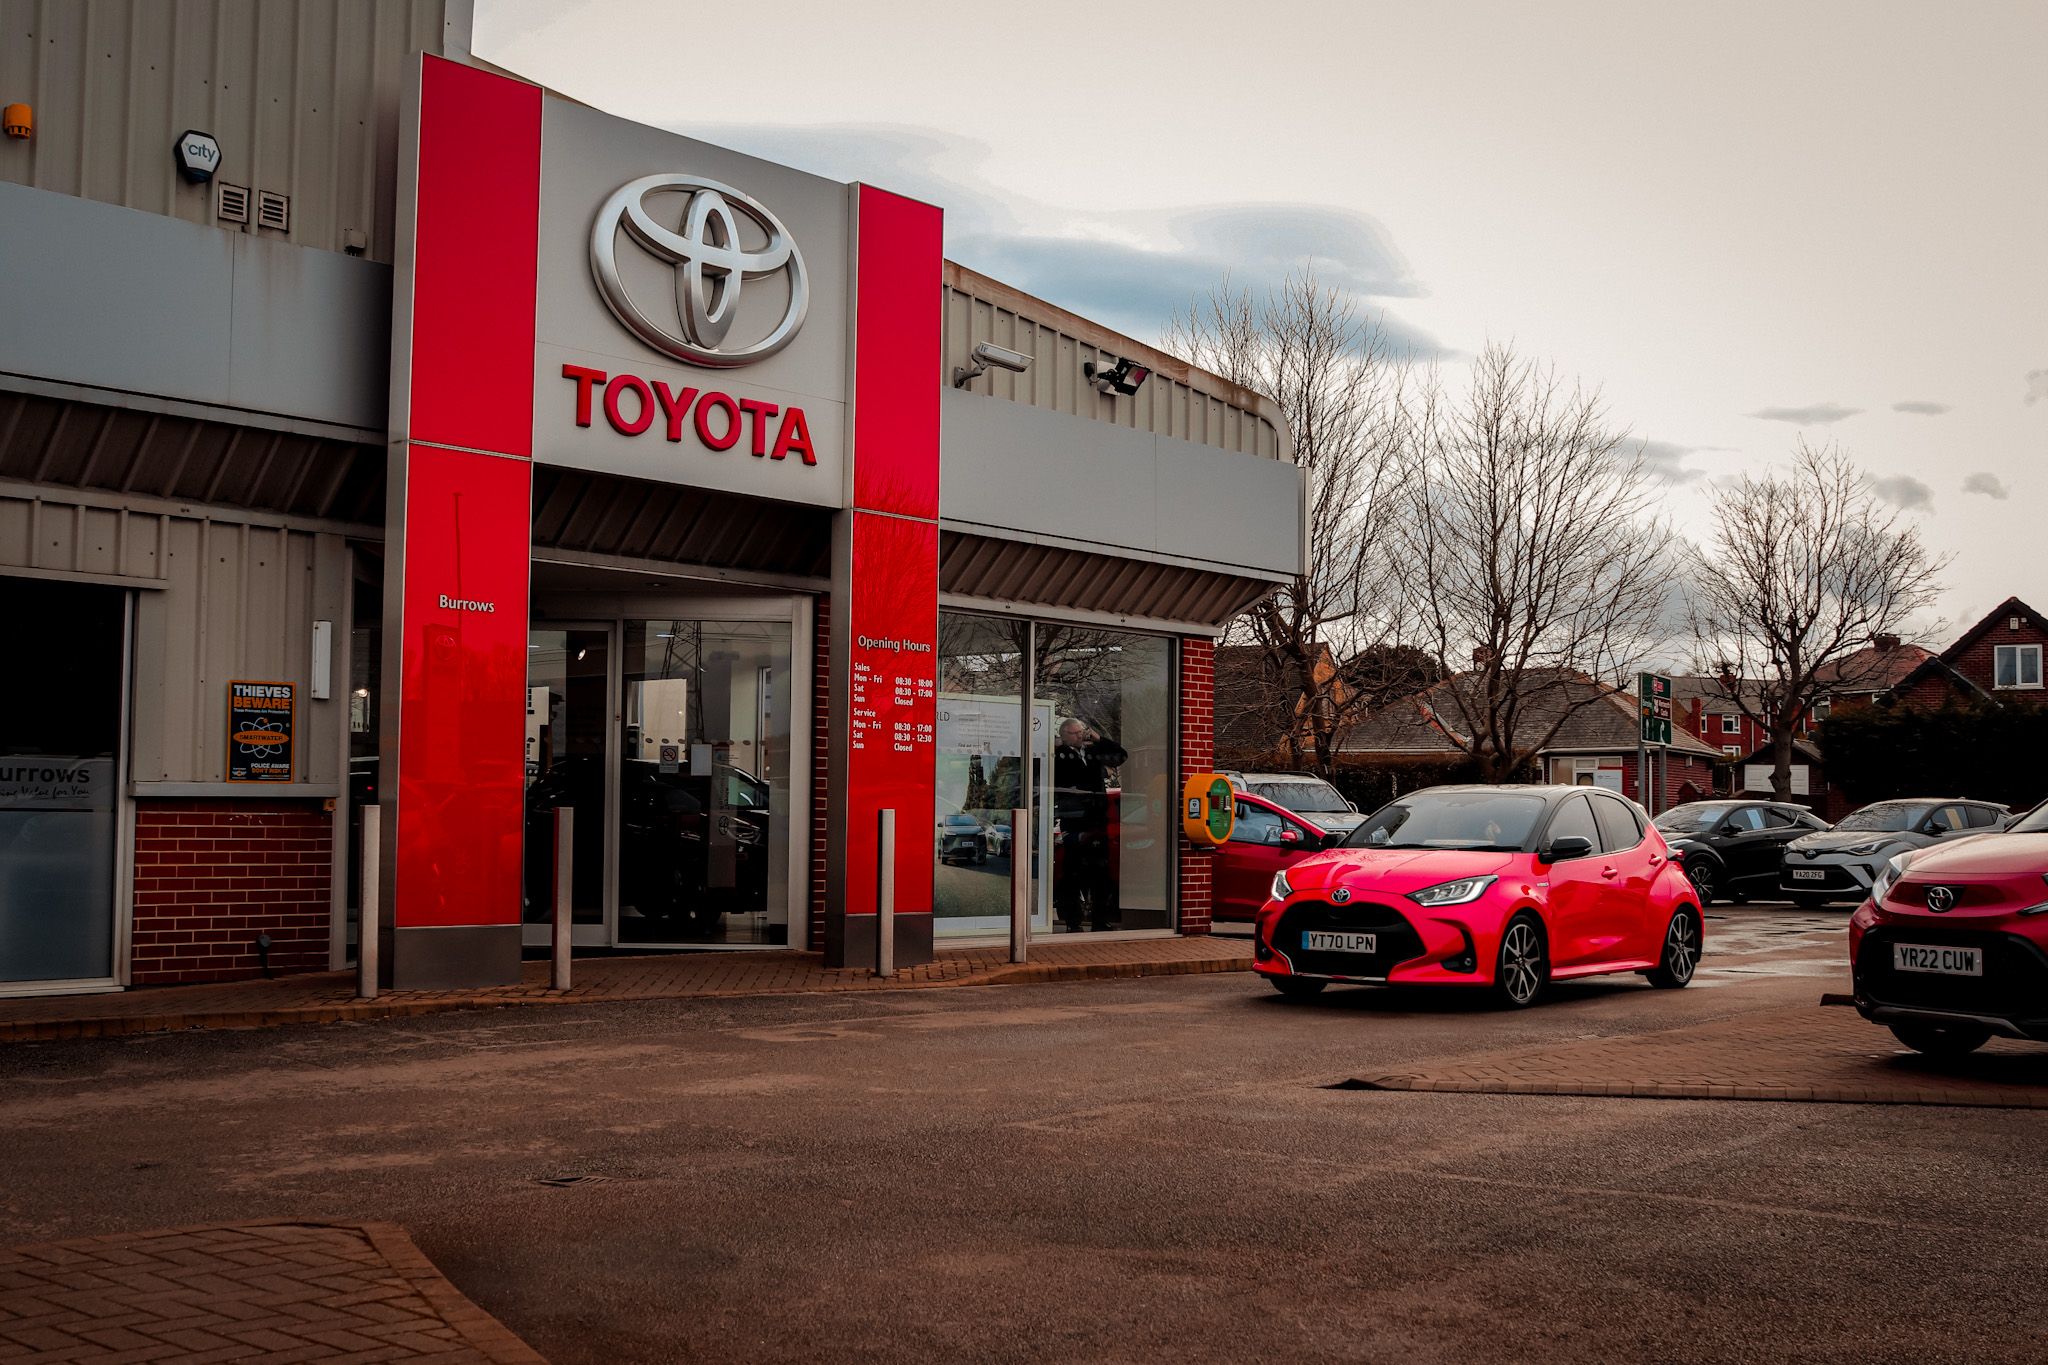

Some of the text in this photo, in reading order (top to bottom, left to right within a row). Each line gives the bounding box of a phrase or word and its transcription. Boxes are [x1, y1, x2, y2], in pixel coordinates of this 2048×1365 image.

[562, 363, 817, 466] TOYOTA
[439, 594, 495, 613] Burrows
[858, 635, 931, 652] Opening Hours
[855, 662, 870, 671] Sales
[854, 673, 867, 682] Mon
[873, 675, 882, 683] Fri
[895, 677, 911, 686] 08:30
[918, 679, 933, 687] 18:00
[234, 685, 290, 698] THIEVES
[854, 684, 864, 692] Sat
[895, 687, 911, 695] 08:30
[918, 689, 932, 697] 17:00
[234, 696, 290, 709] BEWARE
[854, 694, 913, 706] Sun Closed
[854, 708, 876, 717] Service
[853, 720, 866, 728] Mon
[872, 721, 881, 729] Fri
[894, 723, 910, 731] 08:30
[917, 724, 932, 733] 17:00
[894, 733, 910, 741] 08:30
[917, 734, 932, 742] 12:30
[853, 741, 912, 752] Sun Closed
[1311, 934, 1373, 950] YT70 LPN
[1901, 948, 1974, 971] YR22 CUW
